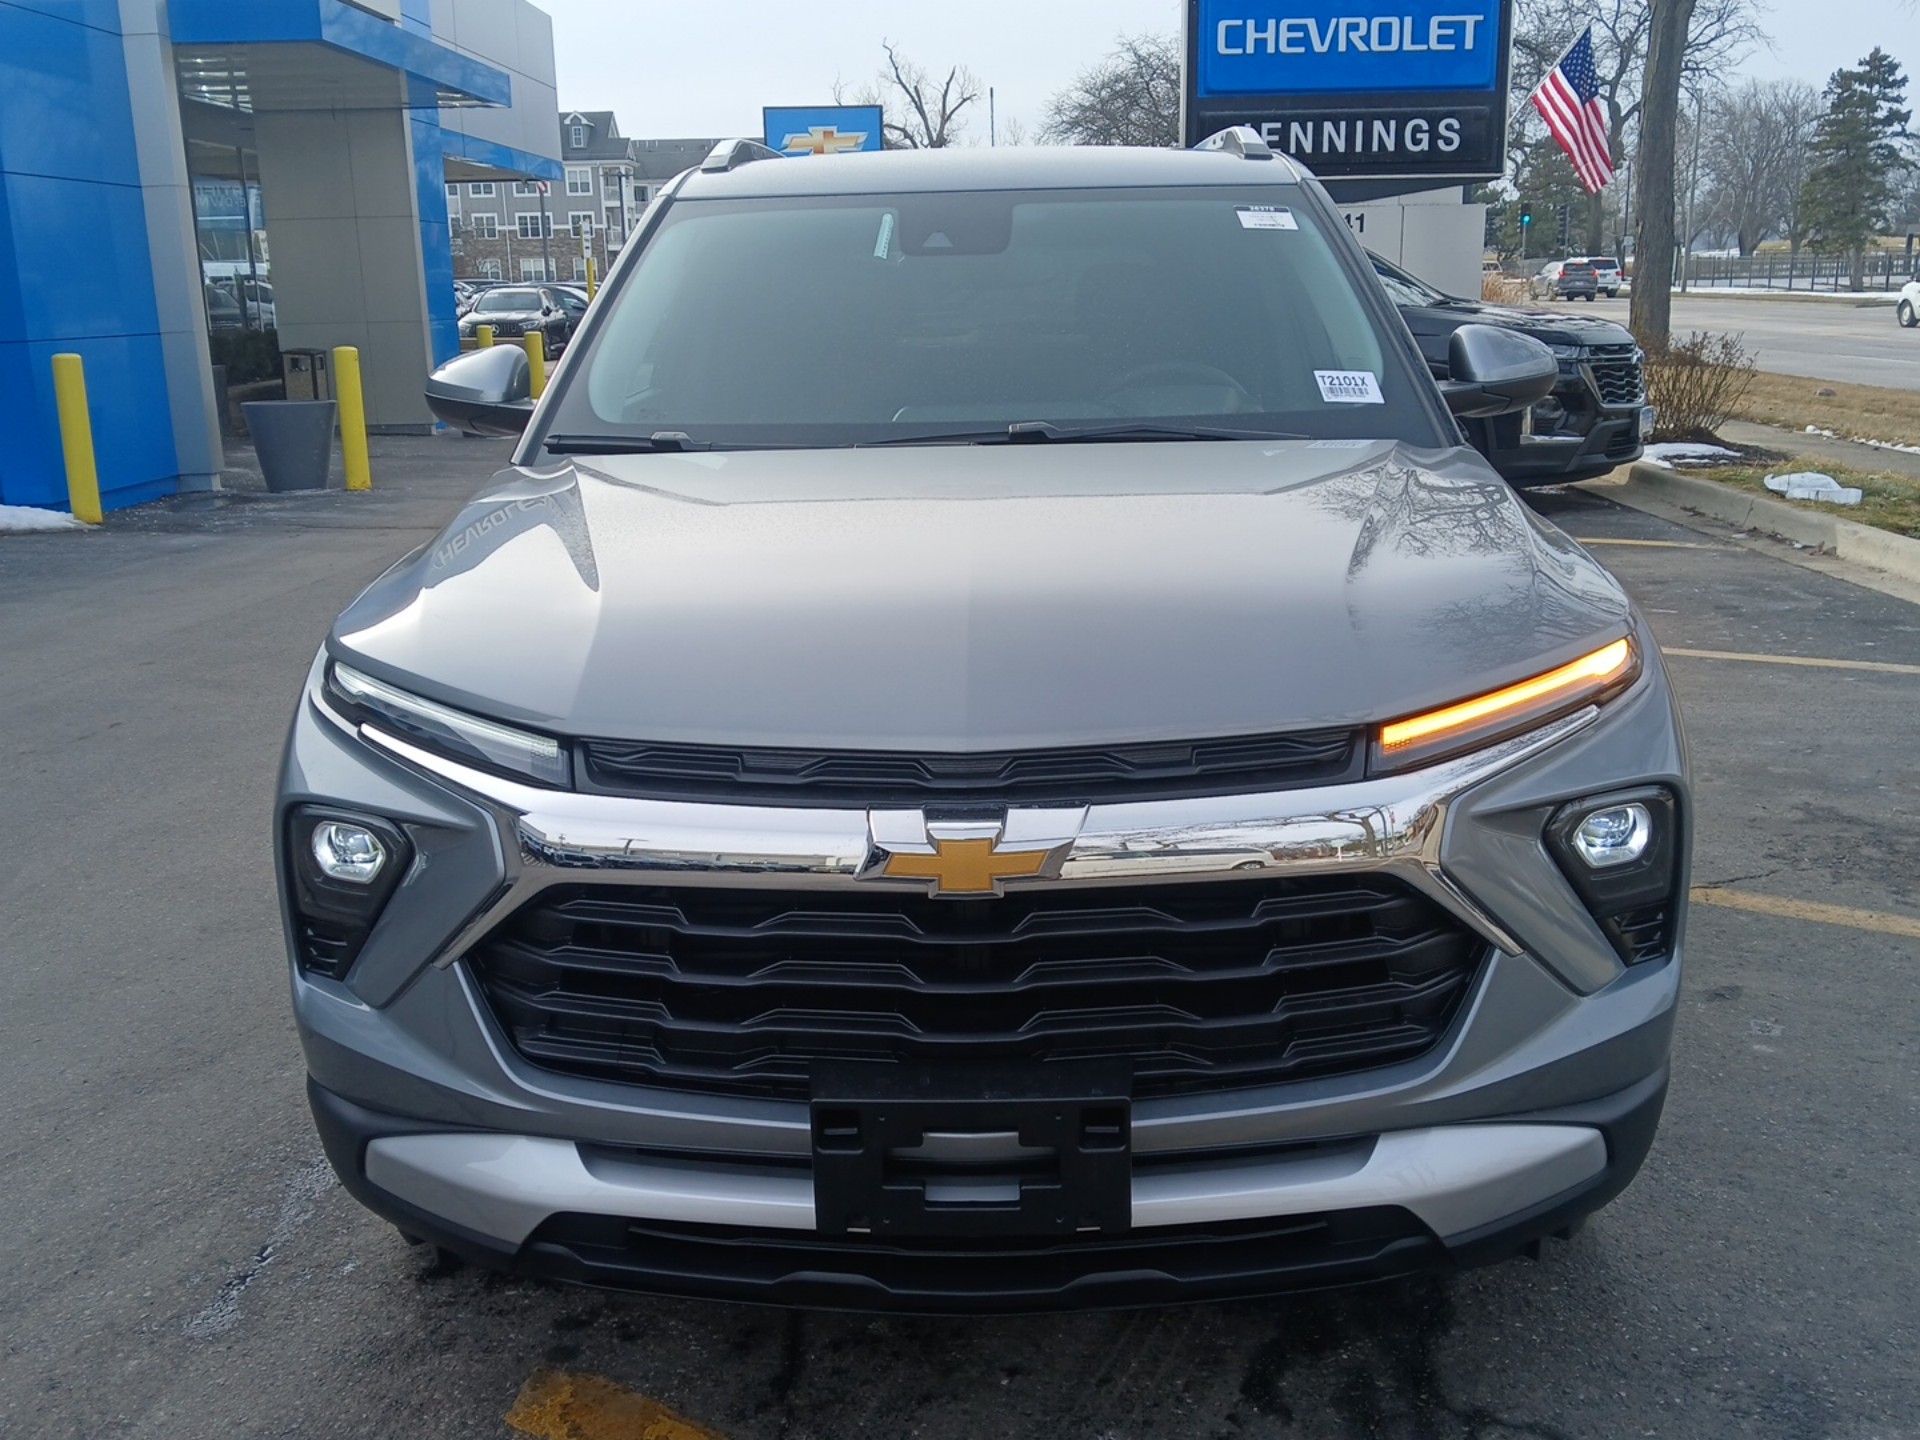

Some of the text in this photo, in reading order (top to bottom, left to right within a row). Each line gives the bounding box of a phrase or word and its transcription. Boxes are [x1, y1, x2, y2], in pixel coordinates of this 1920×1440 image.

[1217, 14, 1485, 54] CHEVROLET
[1244, 117, 1462, 154] ENNINGS
[1318, 375, 1368, 387] T2101X
